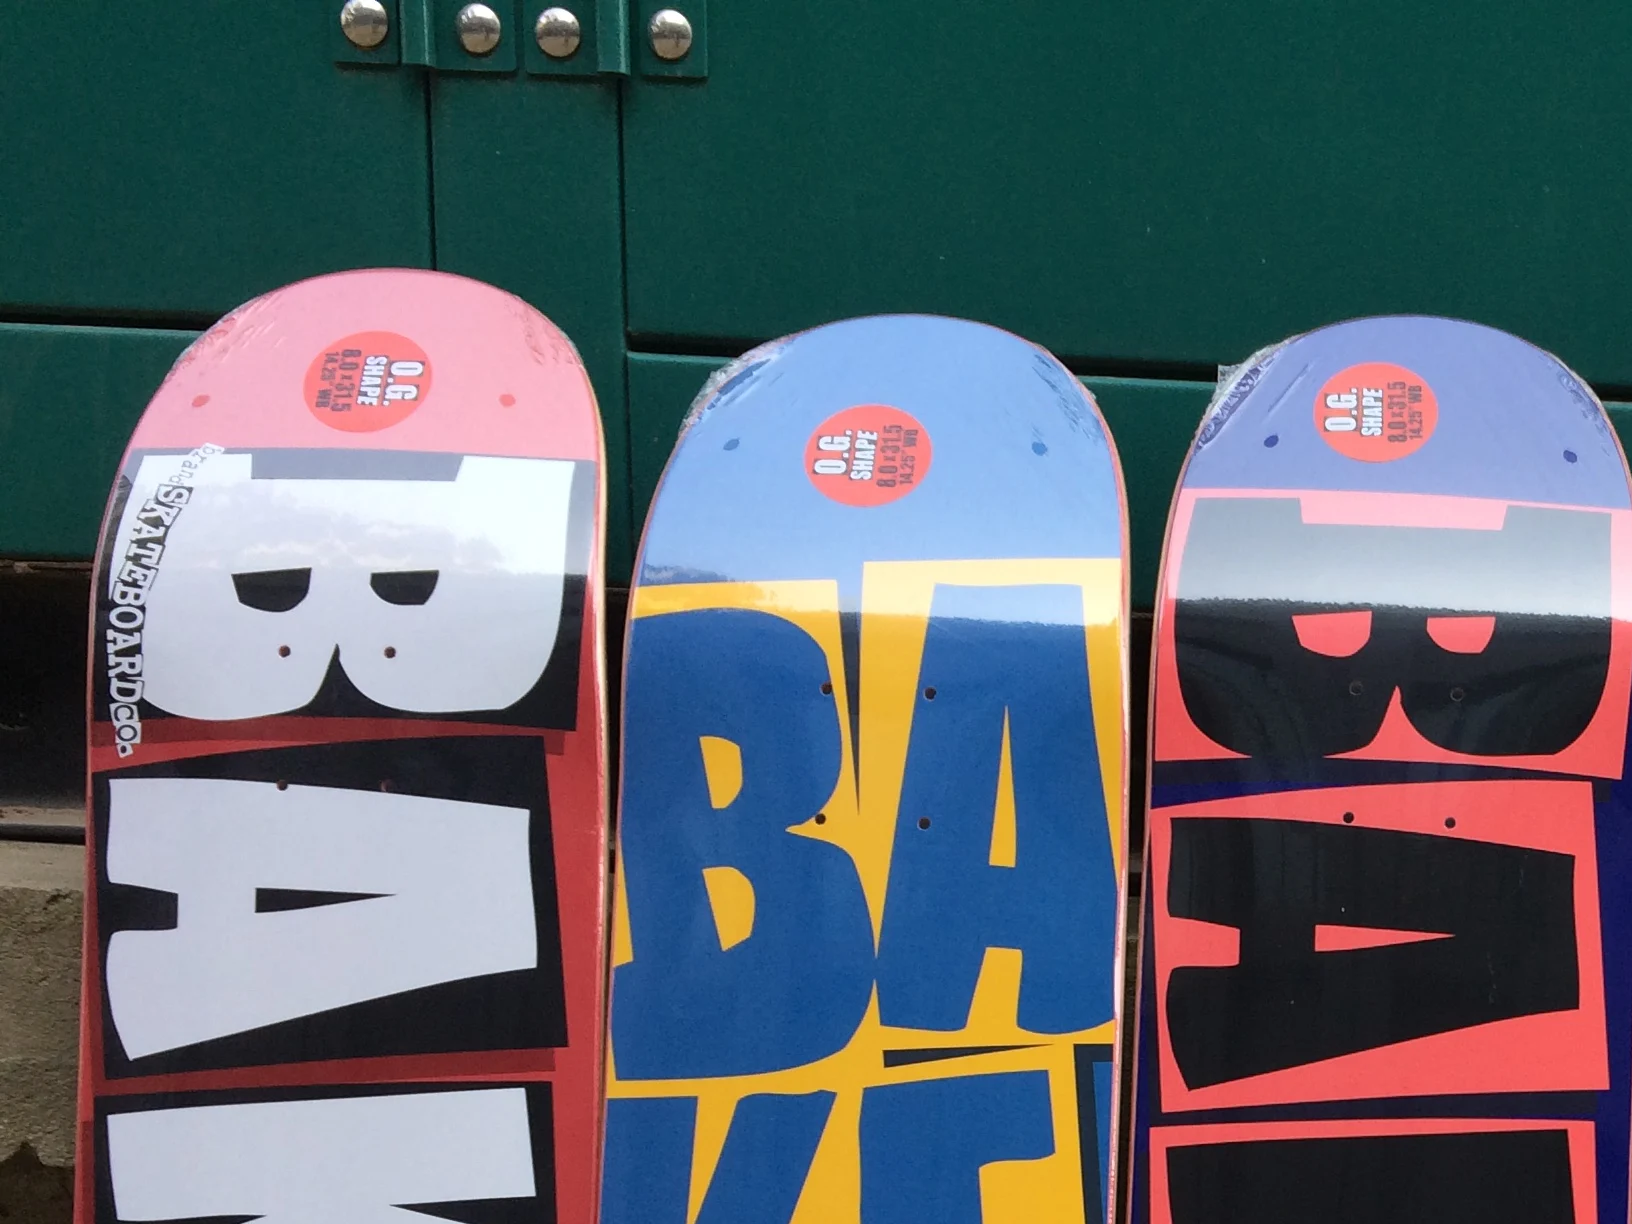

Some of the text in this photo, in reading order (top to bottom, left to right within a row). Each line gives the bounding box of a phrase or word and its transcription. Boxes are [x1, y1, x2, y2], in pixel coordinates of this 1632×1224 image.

[356, 355, 388, 406] SHAPE
[1360, 387, 1383, 436] SHAPE
[849, 430, 878, 480] SHAPE
